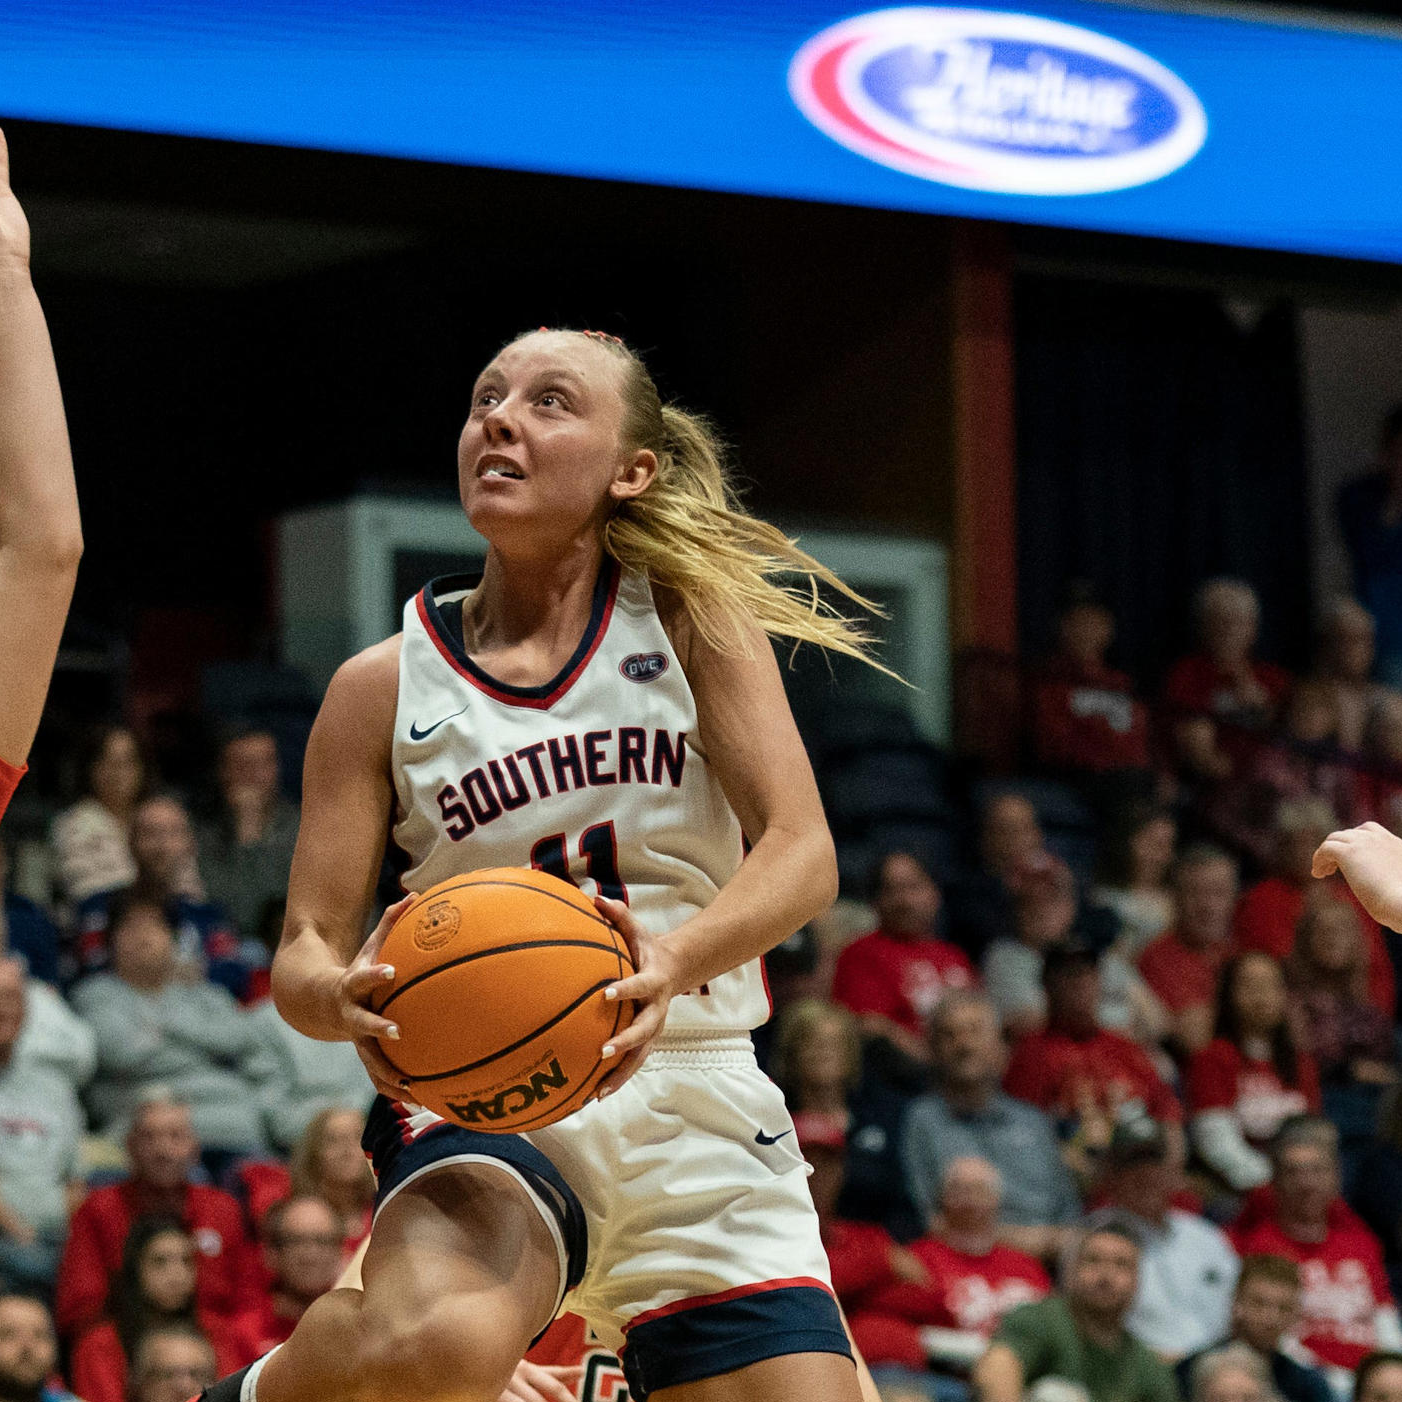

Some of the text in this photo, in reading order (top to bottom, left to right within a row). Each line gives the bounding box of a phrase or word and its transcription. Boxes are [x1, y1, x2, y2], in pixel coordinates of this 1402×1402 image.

[628, 659, 658, 675] OVC
[436, 726, 688, 842] SOUTHERN
[445, 1056, 570, 1123] NCAA
